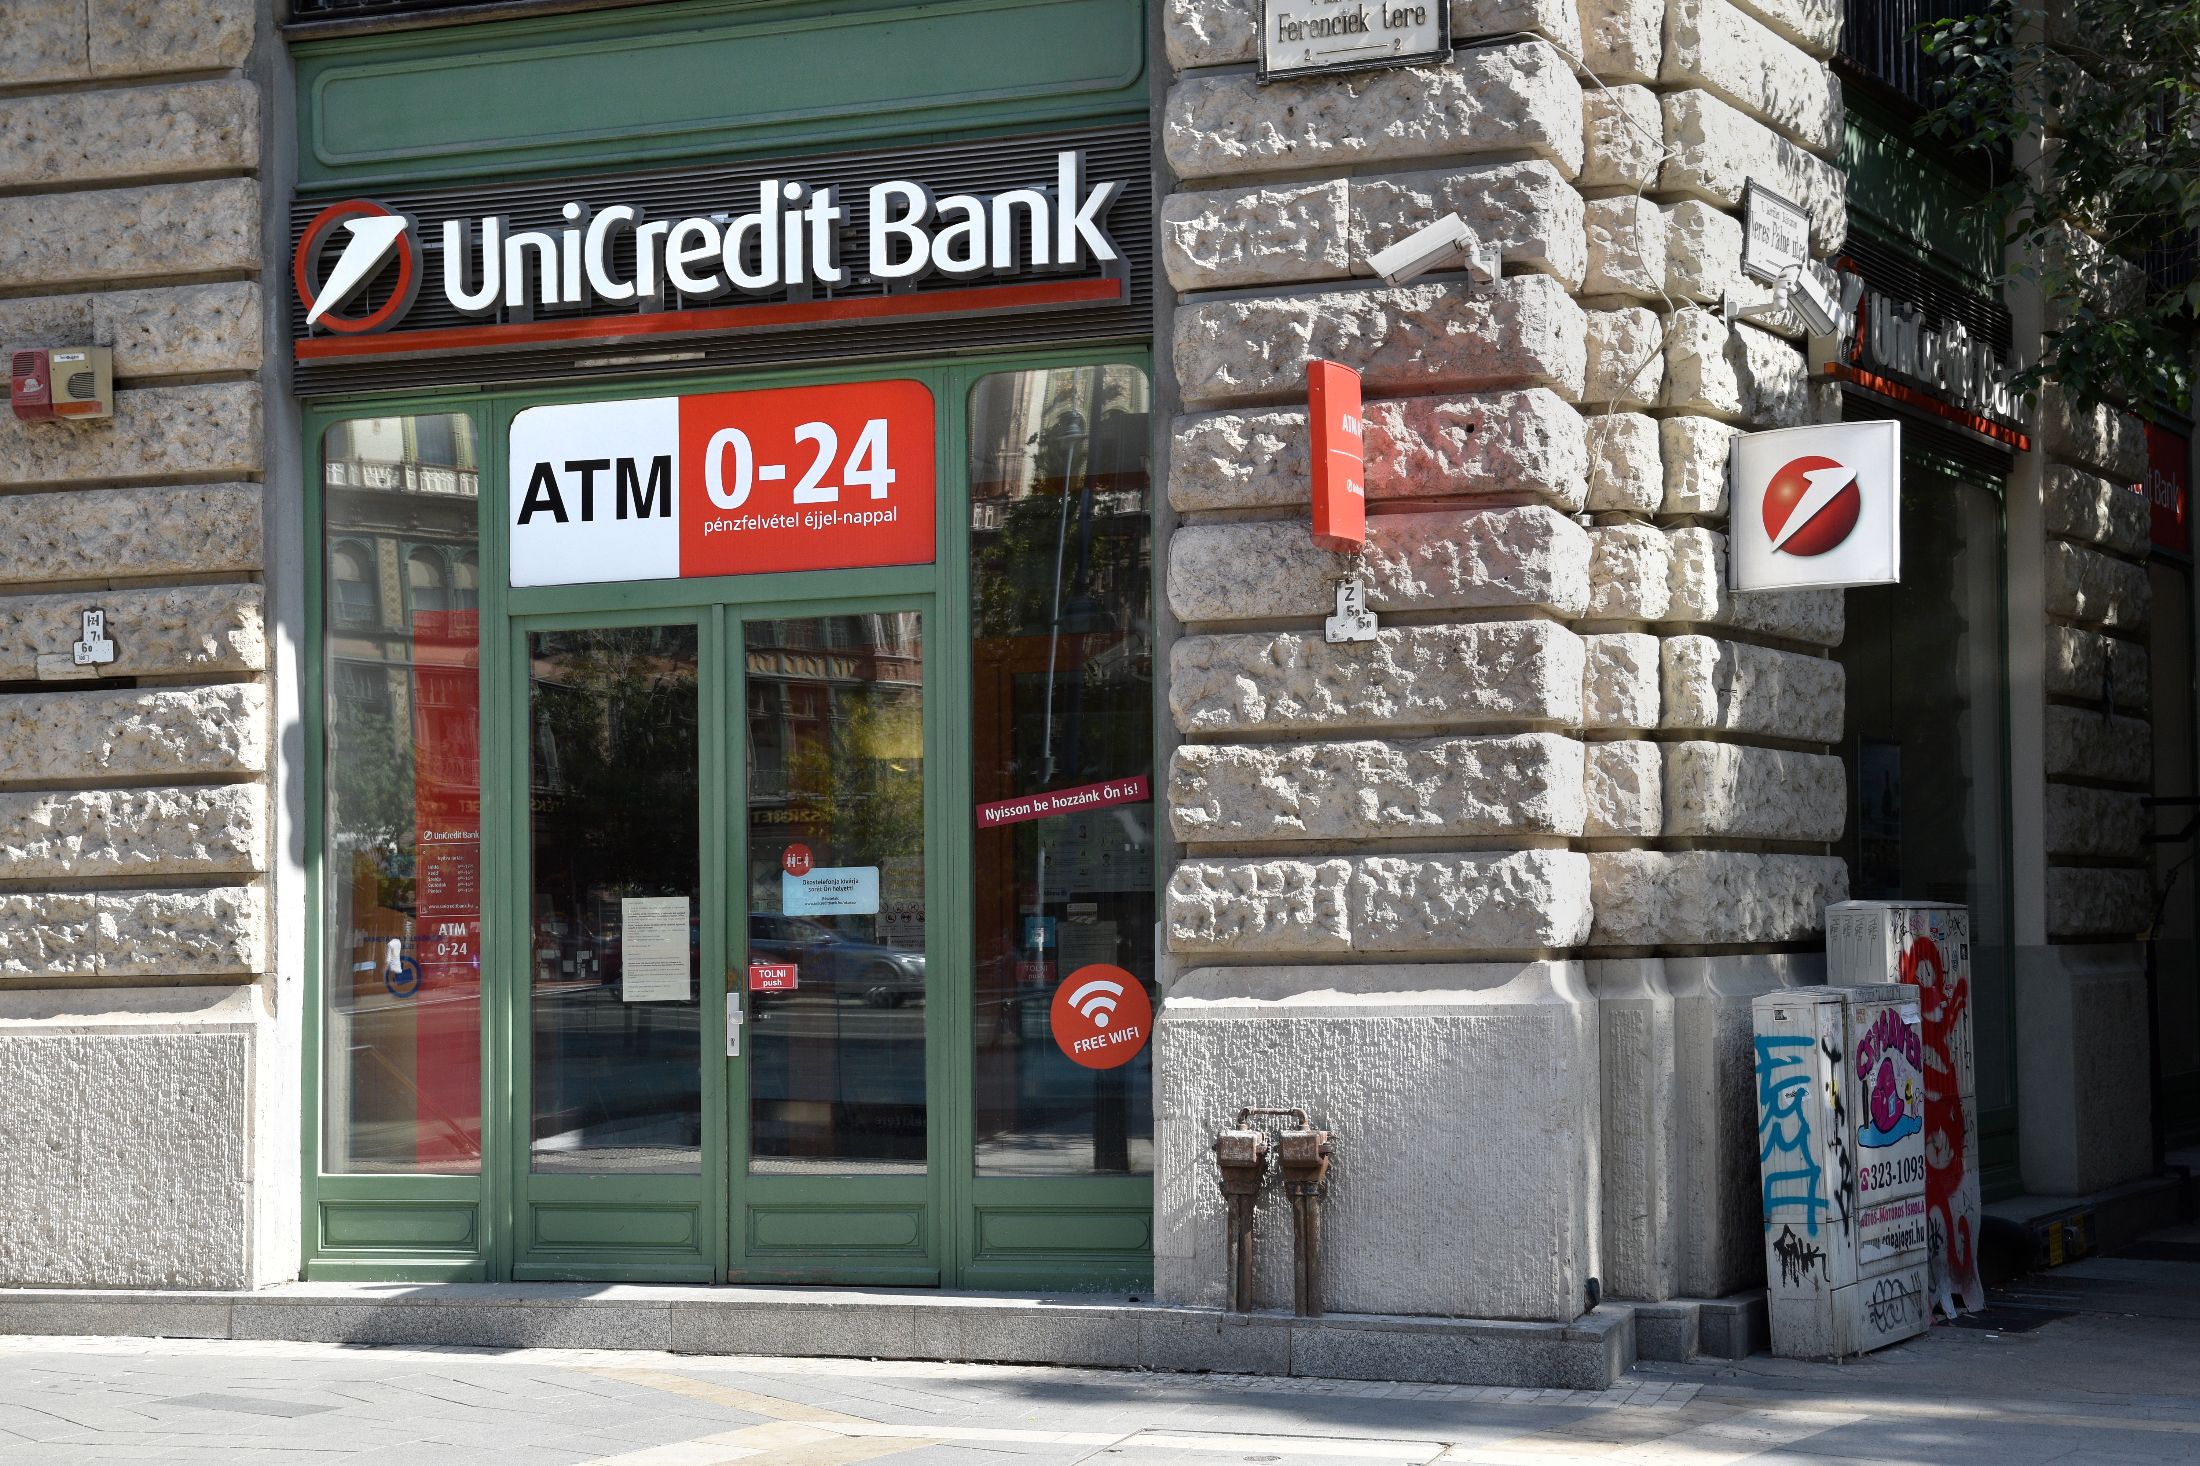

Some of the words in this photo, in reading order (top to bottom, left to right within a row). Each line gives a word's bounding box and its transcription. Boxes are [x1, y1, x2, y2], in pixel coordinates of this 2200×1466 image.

[443, 180, 841, 311] UniCredit
[869, 151, 1117, 279] Bank
[517, 455, 672, 525] ATM
[704, 418, 896, 509] 0-24
[704, 512, 799, 536] pénzfelvétel
[804, 506, 897, 530] éjjel-nappal
[1345, 587, 1355, 601] Z
[985, 804, 1031, 822] Nyisson
[1034, 799, 1049, 812] be
[1052, 791, 1101, 809] hozzánk
[1103, 785, 1121, 799] Ön
[1123, 782, 1139, 796] is!
[434, 831, 462, 839] UniCredit
[463, 830, 480, 838] Bank
[438, 922, 466, 936] ATM
[437, 943, 467, 956] 0-24
[759, 969, 786, 978] TOLNI
[763, 979, 782, 988] push
[1073, 1034, 1107, 1053] FREE
[1108, 1026, 1140, 1044] WIFI
[1870, 1155, 1924, 1190] 323-1093
